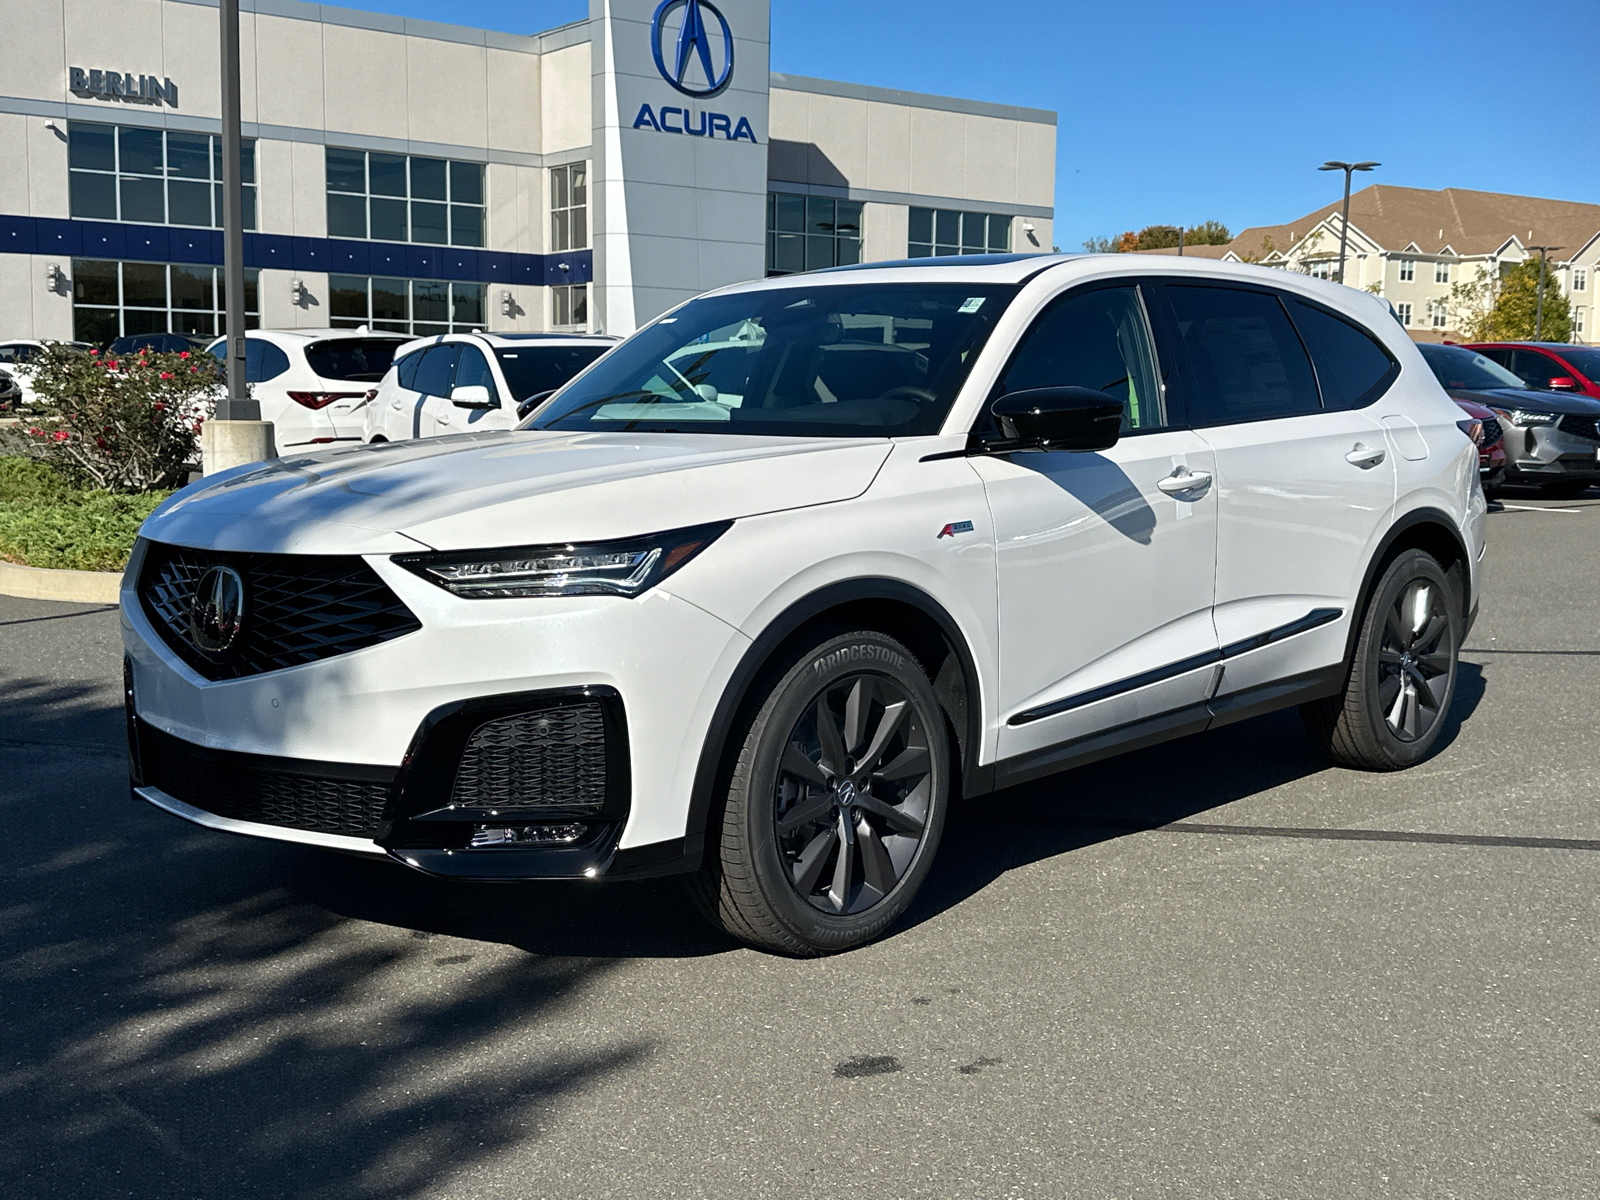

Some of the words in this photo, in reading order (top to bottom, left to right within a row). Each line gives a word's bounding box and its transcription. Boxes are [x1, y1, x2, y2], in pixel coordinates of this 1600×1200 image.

[69, 66, 172, 101] BERLIN
[632, 103, 758, 144] ACURA
[813, 644, 905, 678] BRIDGESTONE
